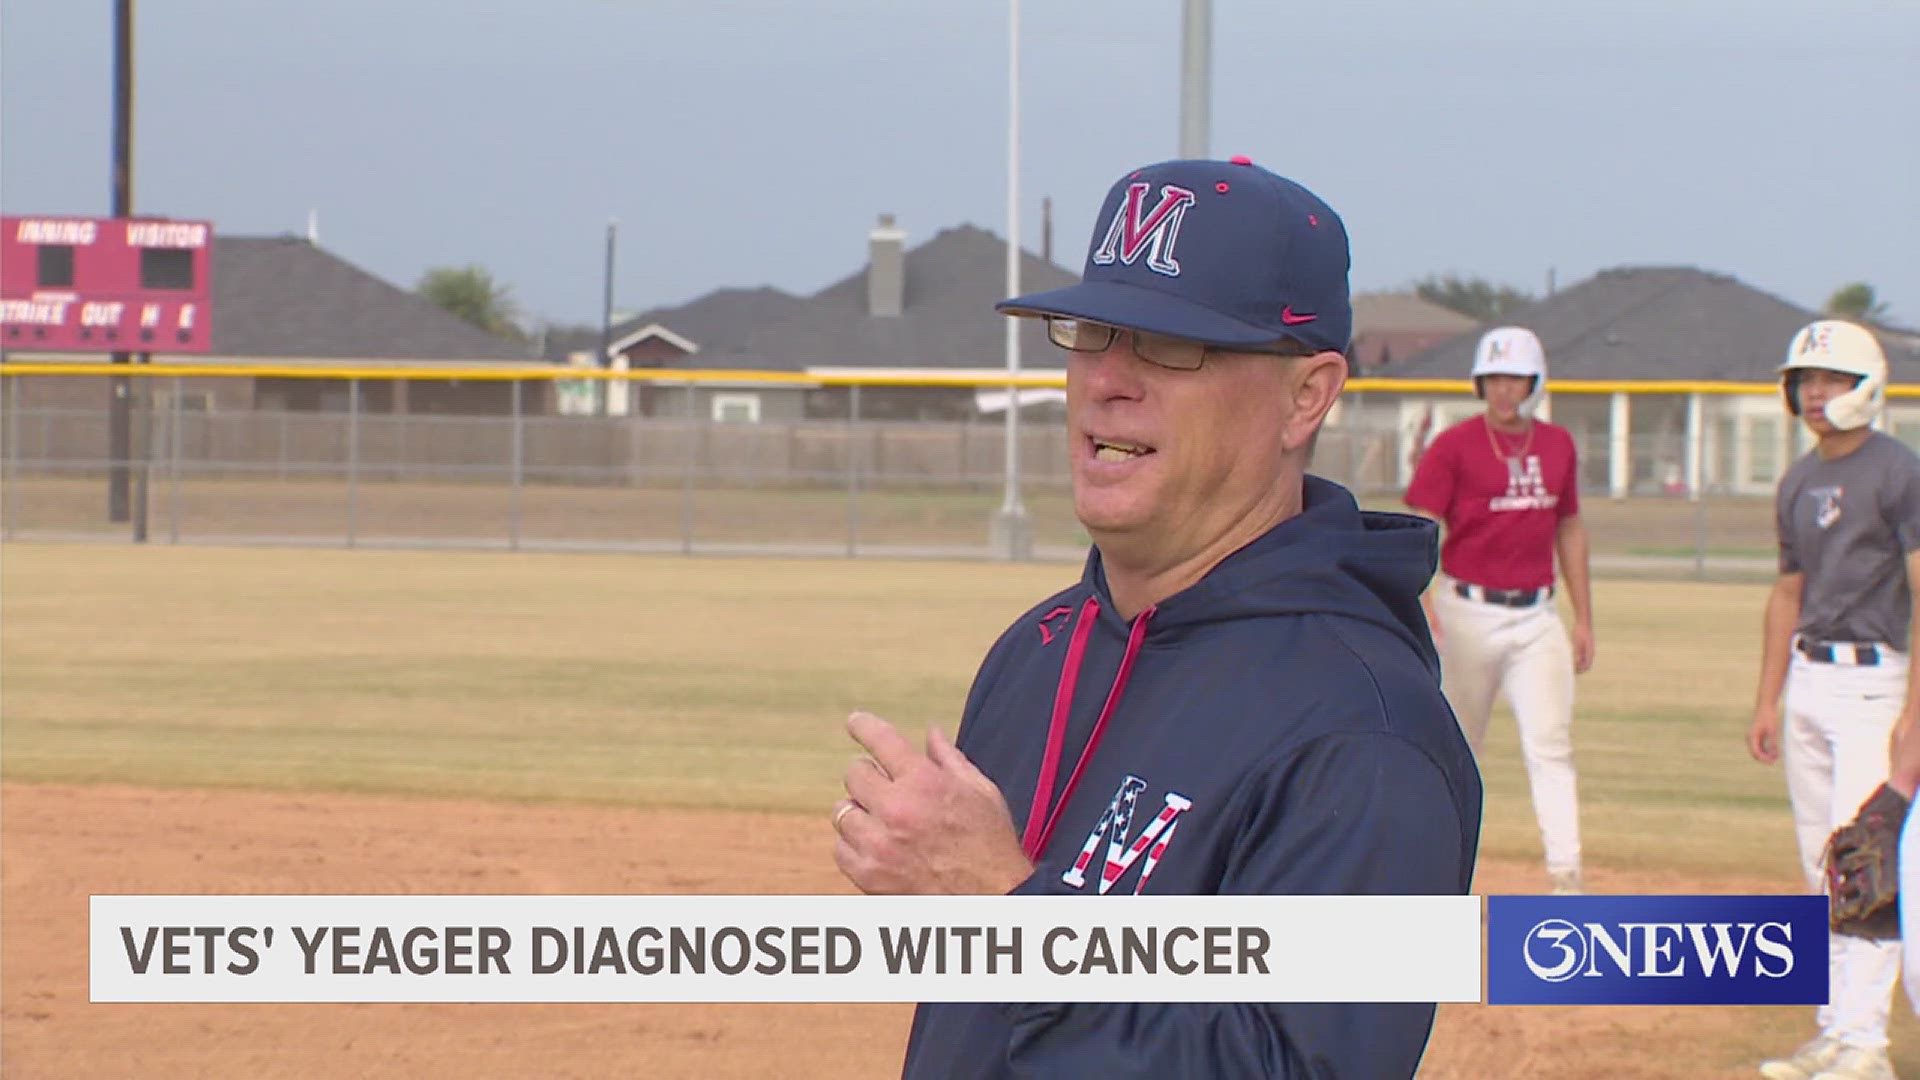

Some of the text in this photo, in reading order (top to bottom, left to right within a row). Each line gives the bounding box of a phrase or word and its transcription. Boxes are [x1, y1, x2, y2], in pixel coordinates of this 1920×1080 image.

[17, 220, 96, 245] INNING
[126, 223, 206, 247] VISITOR
[81, 301, 123, 326] OUT
